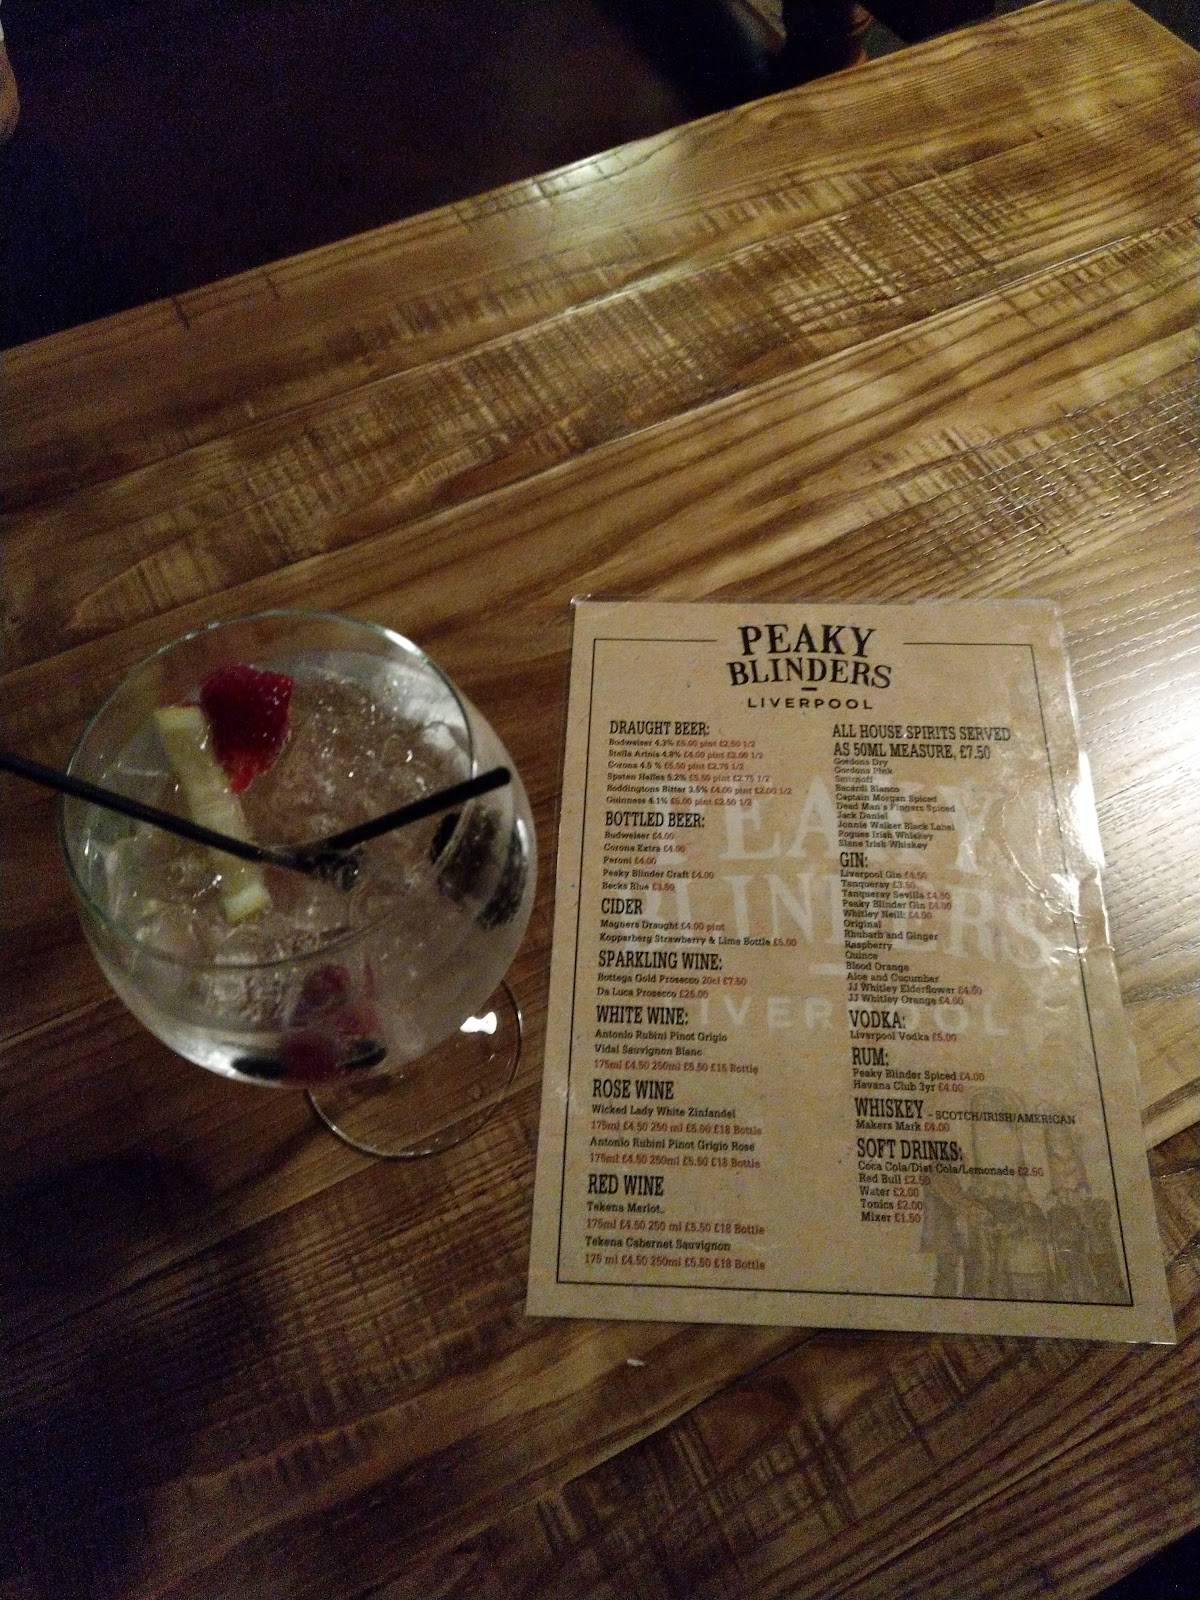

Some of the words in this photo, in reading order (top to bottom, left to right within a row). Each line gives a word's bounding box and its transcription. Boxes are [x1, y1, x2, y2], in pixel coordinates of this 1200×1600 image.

[738, 623, 877, 657] PEAKY
[727, 657, 891, 688] BLINDERS
[748, 698, 872, 709] LIVERPOOL
[609, 720, 670, 735] DRAUGHT
[674, 722, 710, 736] BEER:
[832, 725, 856, 738] ALL
[859, 725, 903, 739] HOUSE
[906, 726, 955, 740] SPIRITS
[959, 727, 1011, 741] SERVED
[834, 743, 850, 756] AS
[854, 743, 886, 757] 50ML
[960, 745, 990, 759] £7.50
[605, 811, 664, 827] BOTTLED
[668, 813, 705, 828] BEER:
[840, 852, 868, 868] GIN:
[601, 898, 642, 914] CIDER
[598, 950, 677, 969] SPARKLING
[682, 952, 722, 970] WINE:
[596, 1005, 642, 1024] WHITE
[647, 1007, 688, 1025] WINE:
[849, 1010, 905, 1029] VODKA:
[852, 1047, 888, 1066] RUM:
[593, 1079, 630, 1098] ROSE
[635, 1080, 674, 1100] WINE
[855, 1098, 924, 1119] WHISKEY
[857, 1138, 895, 1158] SOFT
[901, 1139, 963, 1161] DRINKS:
[588, 1174, 618, 1194] RED
[624, 1175, 664, 1196] WINE
